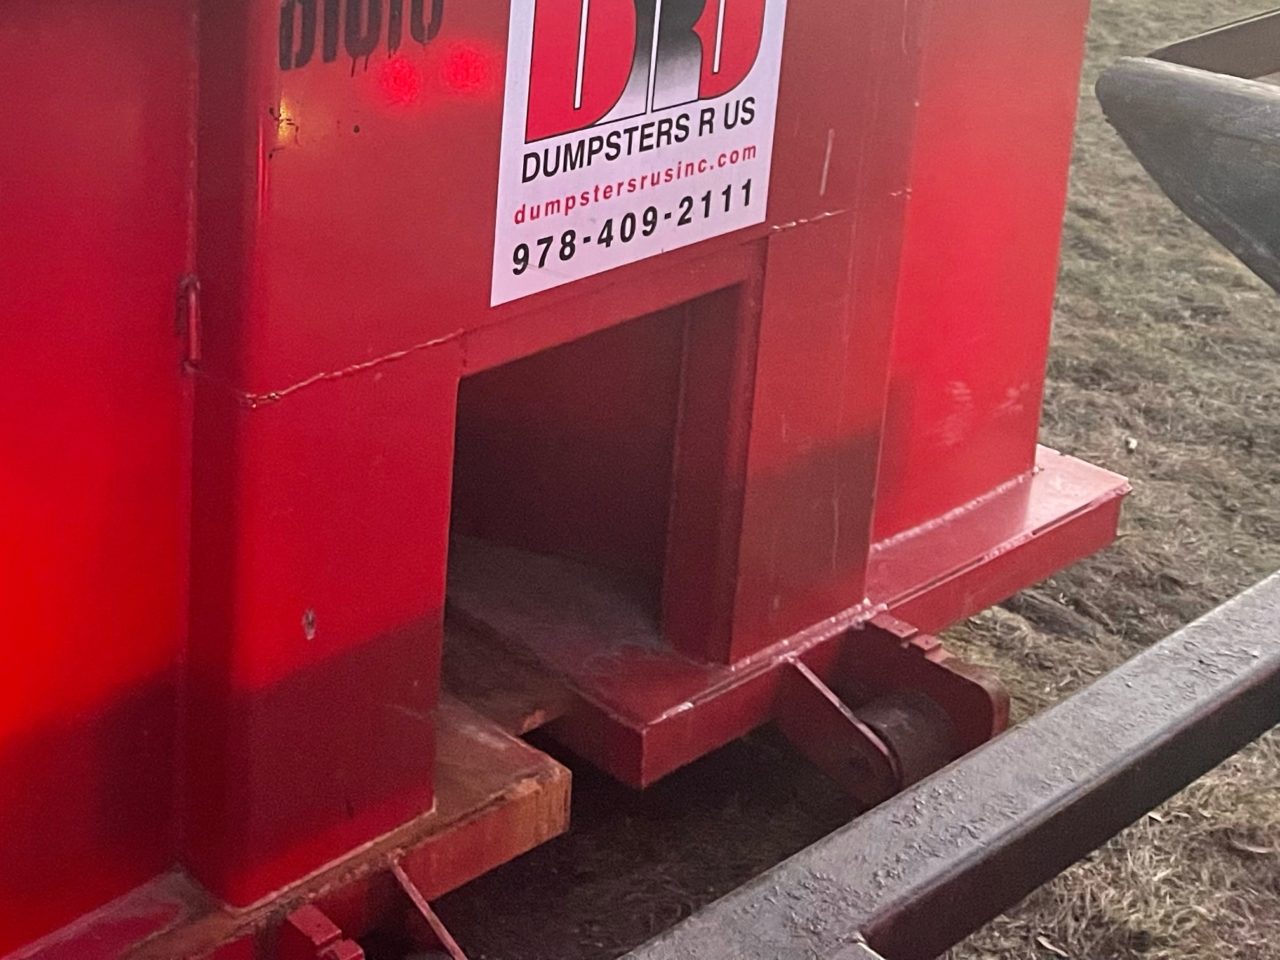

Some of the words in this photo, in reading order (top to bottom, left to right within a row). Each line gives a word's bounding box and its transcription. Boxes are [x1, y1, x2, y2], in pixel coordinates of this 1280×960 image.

[521, 112, 690, 184] DUMPSTERS
[699, 107, 716, 138] R
[723, 96, 756, 130] US
[511, 178, 754, 277] 978-409-2111
[514, 144, 758, 226] dumpstersrusinc.com
